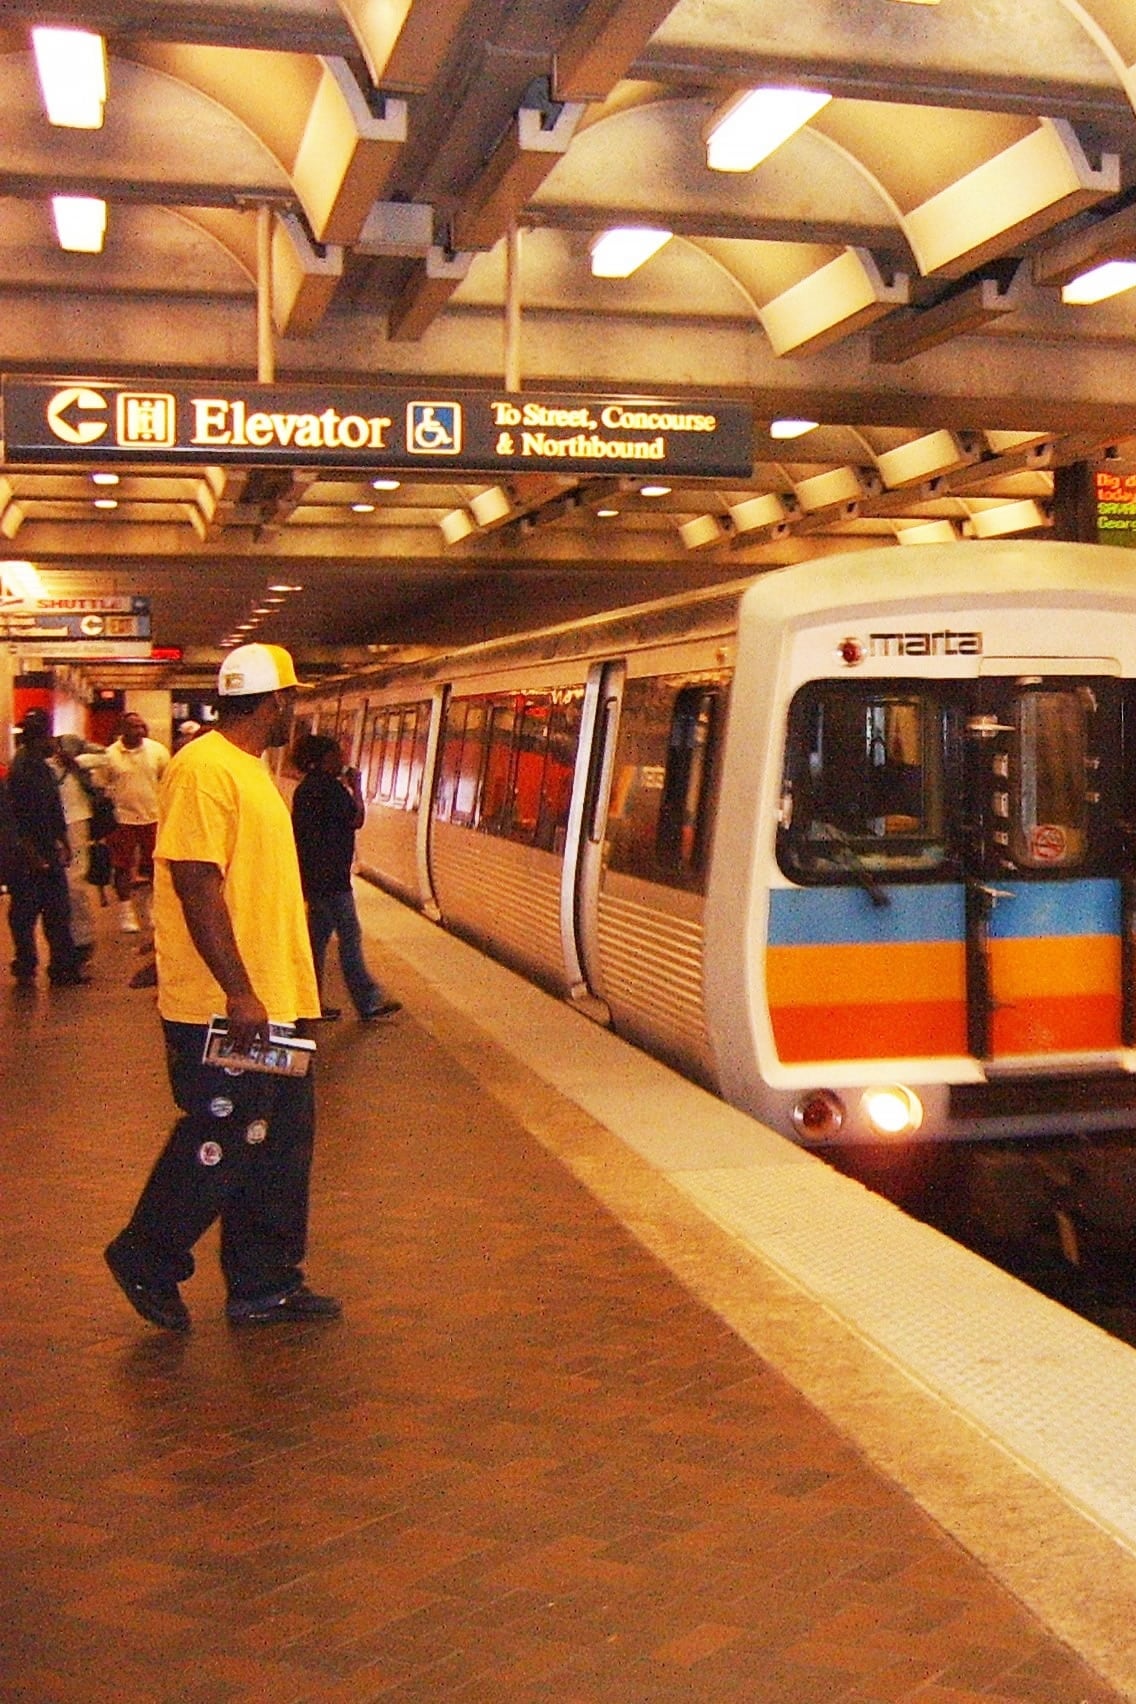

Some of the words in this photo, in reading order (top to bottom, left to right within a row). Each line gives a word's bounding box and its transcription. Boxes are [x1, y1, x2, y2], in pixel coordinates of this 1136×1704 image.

[190, 398, 392, 449] Elevator
[490, 401, 522, 426] To
[522, 402, 599, 431] Street,
[600, 405, 717, 432] Concourse
[495, 431, 515, 456] &
[521, 431, 666, 460] Northbound
[37, 598, 121, 610] SHUTTLE
[868, 629, 984, 657] marta
